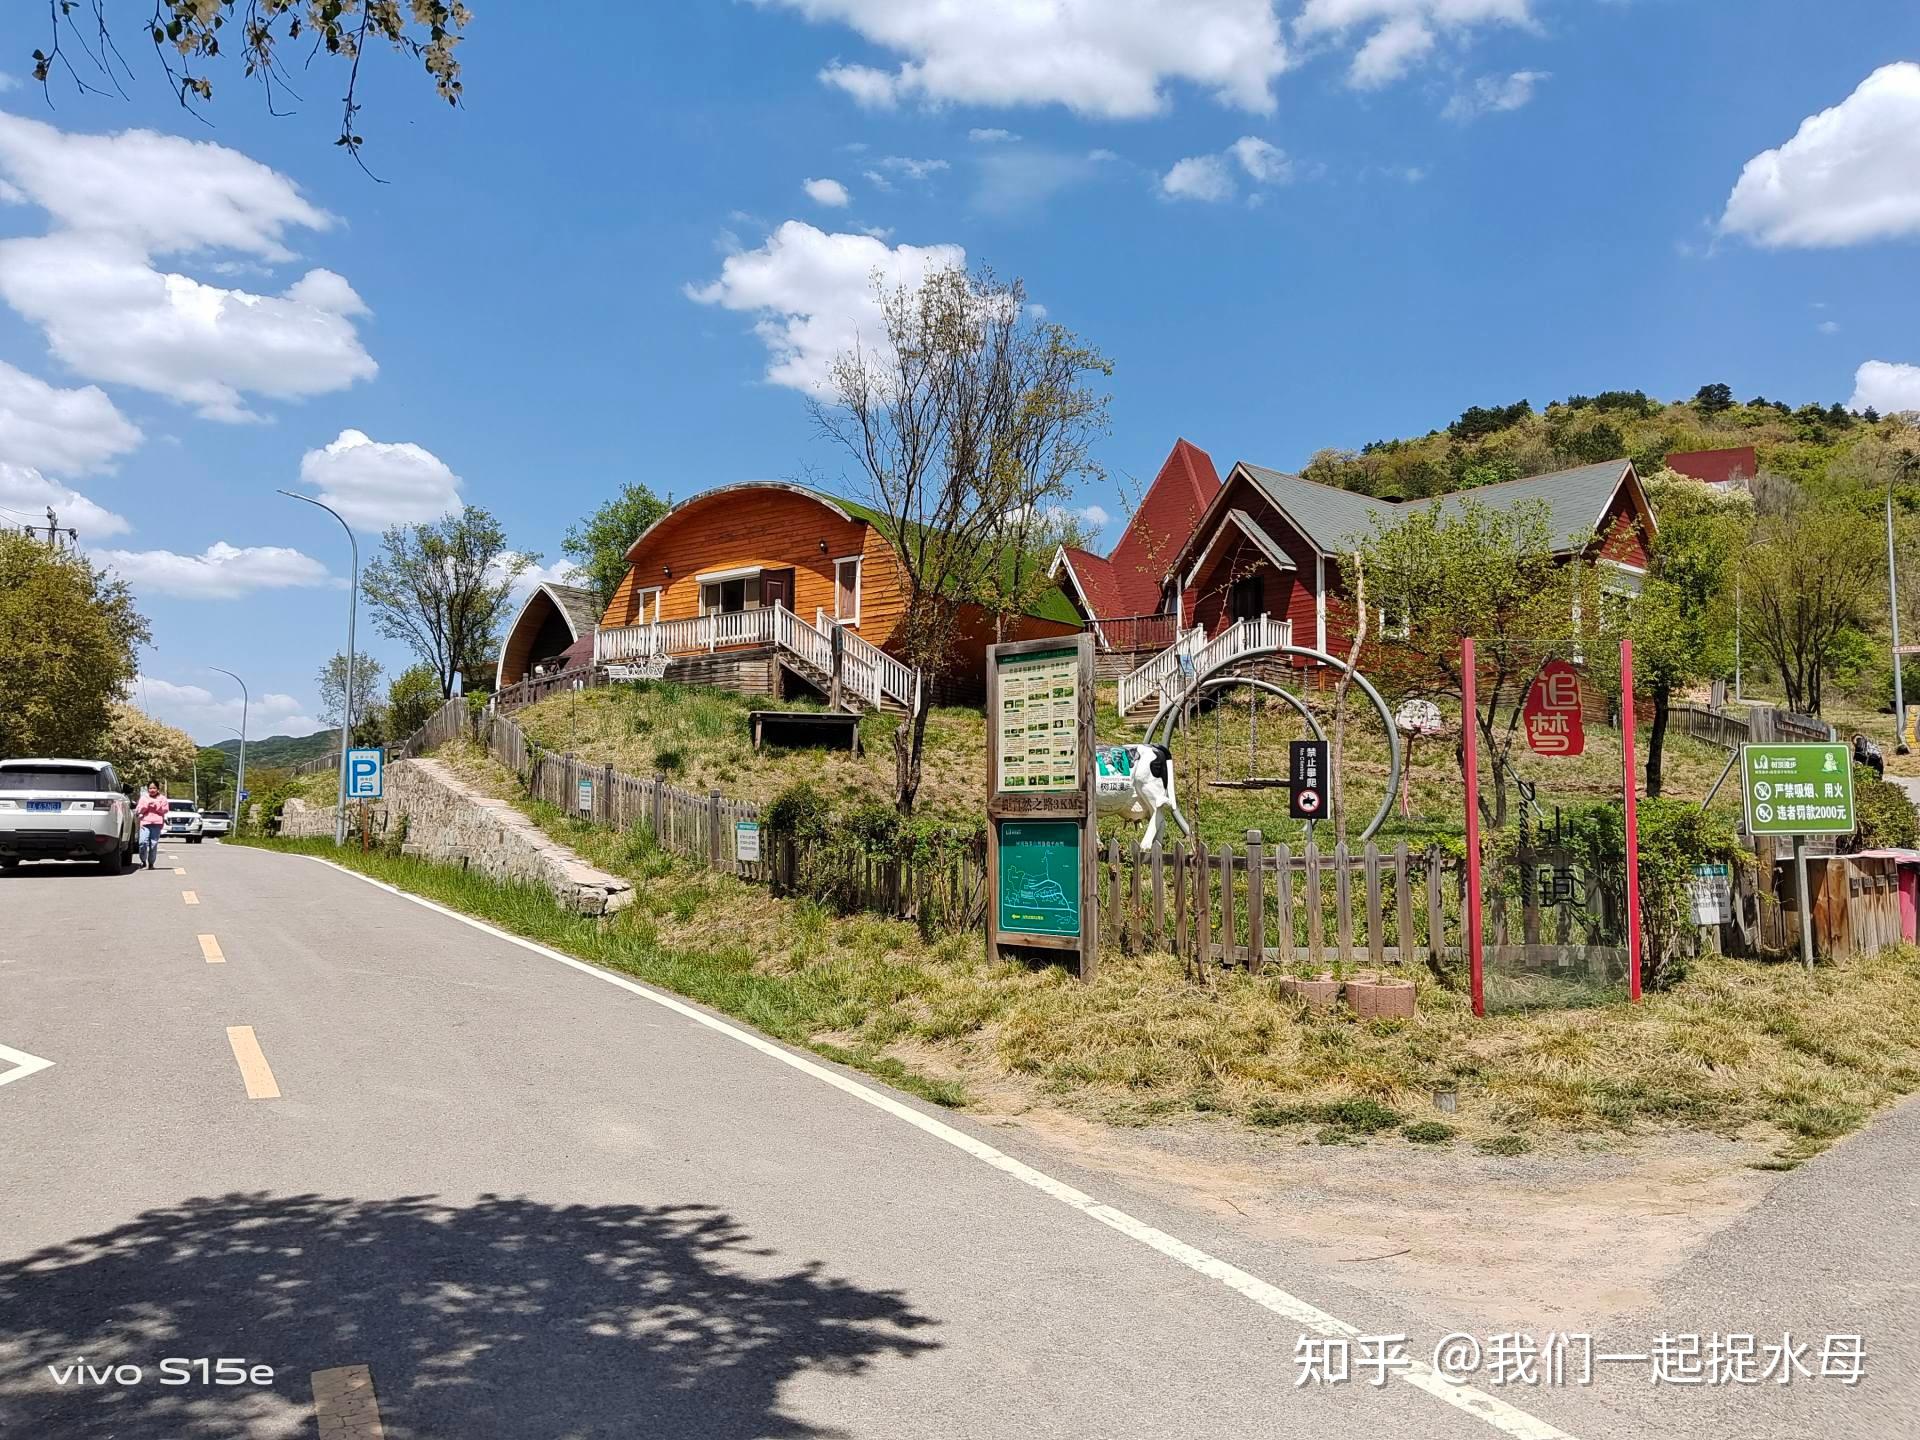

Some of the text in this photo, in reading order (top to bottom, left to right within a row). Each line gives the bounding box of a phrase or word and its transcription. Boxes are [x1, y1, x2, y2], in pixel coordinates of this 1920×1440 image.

[1530, 670, 1578, 752] 追梦
[352, 759, 377, 793] P
[1774, 783, 1844, 799] 严禁吸烟、用火
[1517, 780, 1536, 849] Dream
[1776, 804, 1847, 821] 违者罚款2000元
